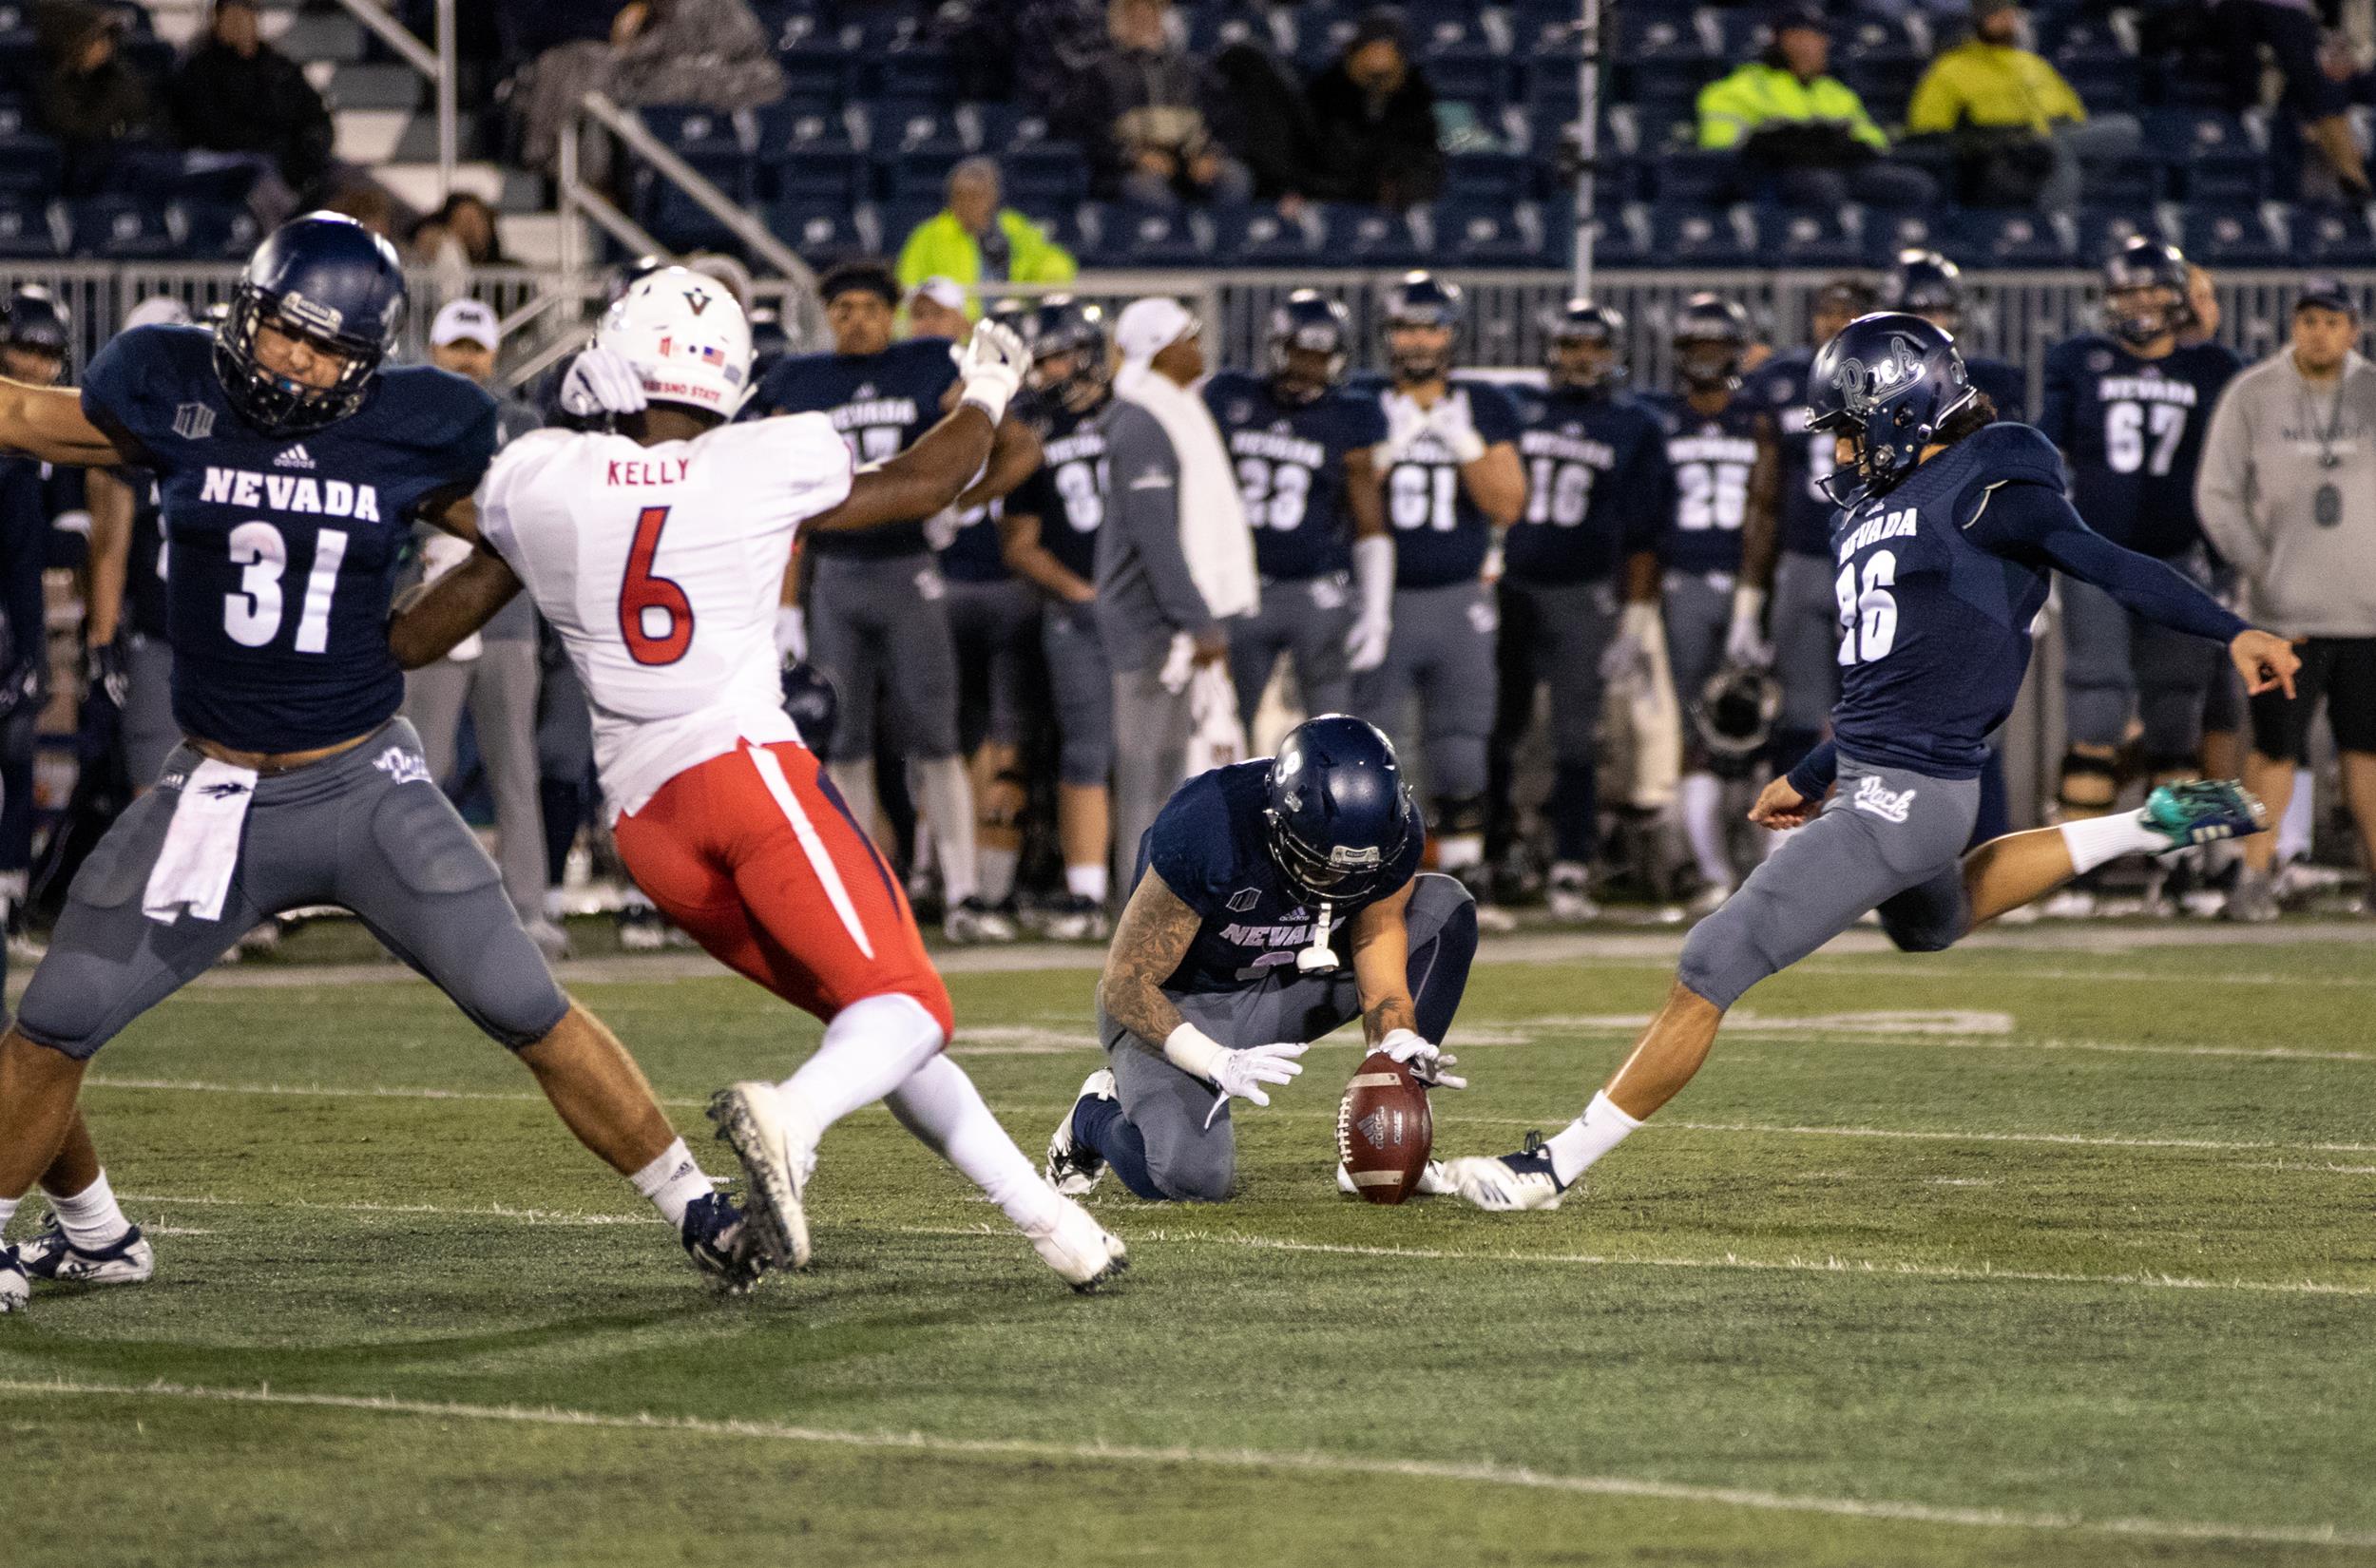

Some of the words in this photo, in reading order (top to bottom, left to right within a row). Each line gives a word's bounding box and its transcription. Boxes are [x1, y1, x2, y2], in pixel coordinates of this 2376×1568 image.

[690, 386, 721, 403] STATE
[2106, 400, 2187, 476] 67
[274, 458, 316, 469] adidas
[607, 458, 689, 486] KELLY
[200, 467, 380, 523] NEVADA
[223, 520, 348, 654] 31
[618, 505, 696, 667] 6
[1854, 775, 1917, 823] Pack
[1278, 914, 1312, 923] adidas
[1374, 1105, 1385, 1150] adidas
